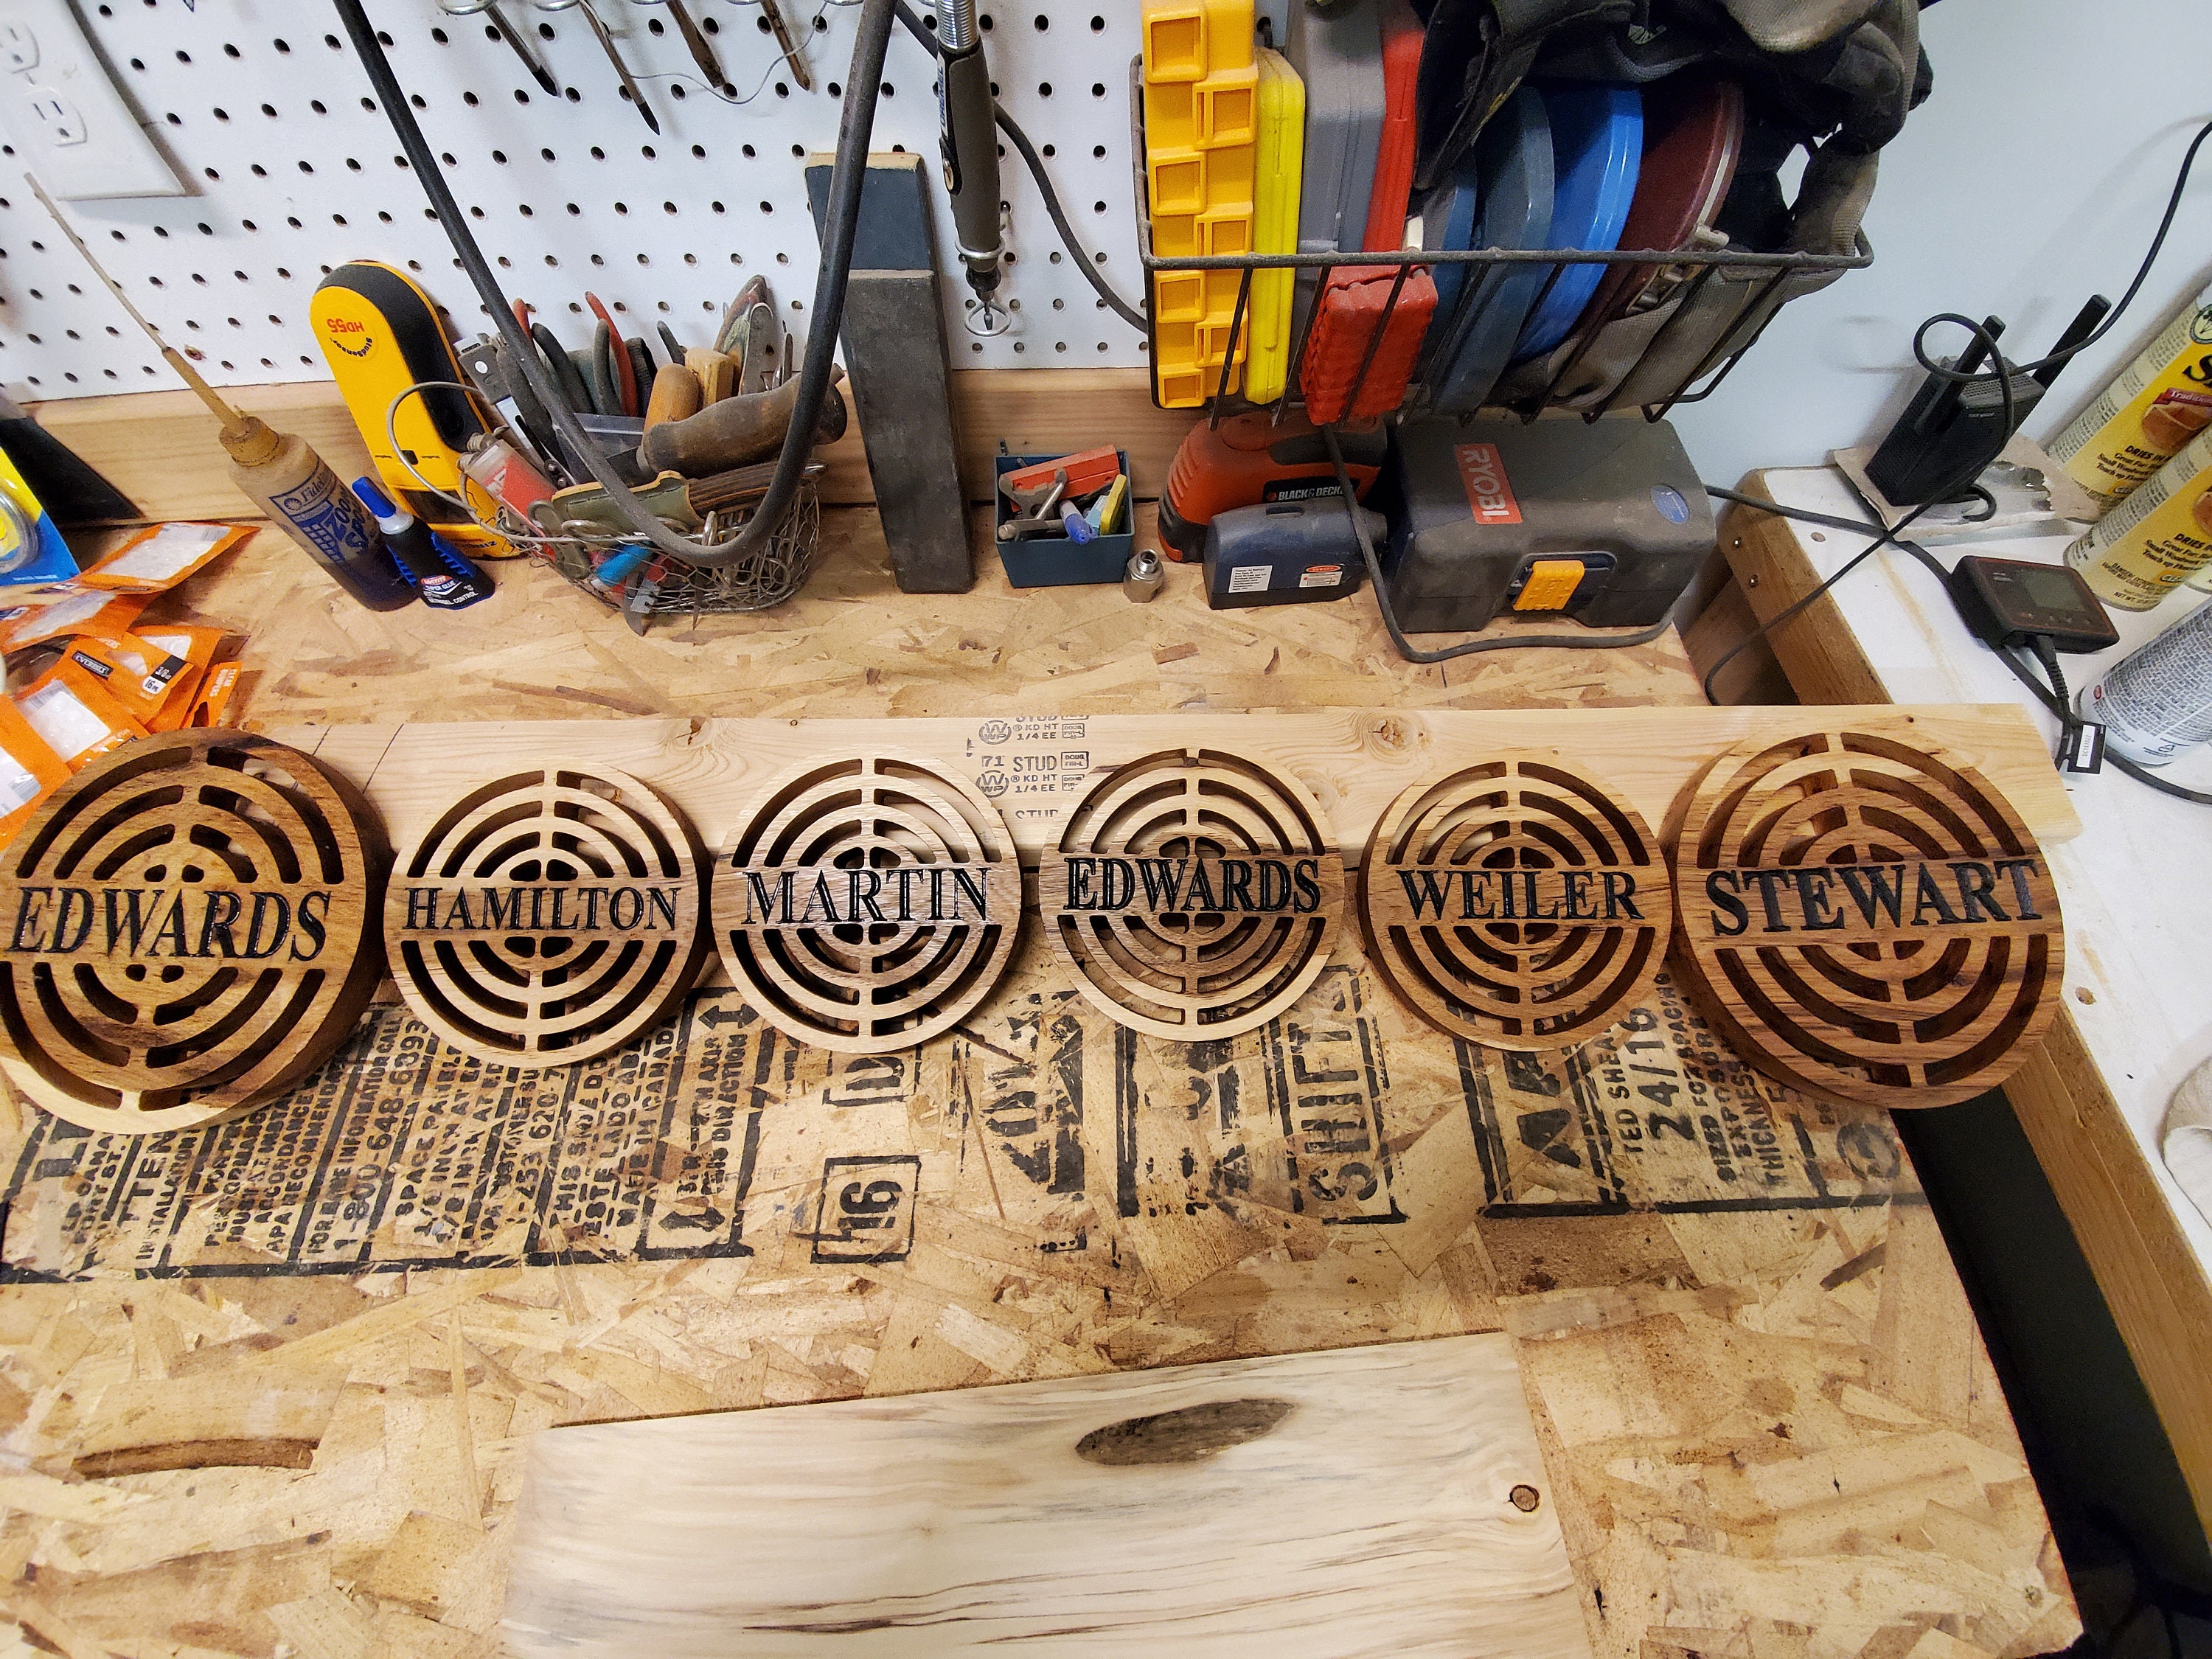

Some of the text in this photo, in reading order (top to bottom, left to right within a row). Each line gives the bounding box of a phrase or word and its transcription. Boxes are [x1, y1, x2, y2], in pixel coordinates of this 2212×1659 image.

[937, 66, 946, 128] DREMEL
[327, 319, 364, 333] HD55
[1463, 448, 1509, 516] RYOBI
[2125, 445, 2153, 459] DRIES
[2174, 532, 2205, 549] DRIES
[145, 678, 154, 690] 16
[1013, 755, 1057, 772] STUD
[403, 886, 681, 931] HAMILTON
[742, 867, 992, 925] MARTIN
[1064, 858, 1320, 915] EDWARDS
[1396, 869, 1645, 921] WEILER
[1705, 859, 2043, 937] STEWART
[7, 886, 330, 961] EDWARDS
[518, 1068, 539, 1092] SU
[712, 1033, 748, 1143] DIRECTION
[1618, 1006, 1696, 1140] 24/16
[1653, 973, 1736, 1183] SIZED FOR SPACING
[308, 1220, 332, 1253] FOR
[336, 1056, 389, 1163] INFORMATION
[375, 1017, 403, 1054] CALL
[333, 1020, 431, 1251] 1-800-648-6393
[472, 1098, 495, 1122] AT
[600, 1093, 630, 1160] LADO
[1287, 1022, 1378, 1201] SHIFT
[76, 1133, 114, 1196] CANA
[116, 1131, 177, 1226] TTEN
[204, 1105, 271, 1246] PERFORMANC
[256, 1094, 313, 1222] ACCORDANCE
[395, 1135, 429, 1217] SPACE
[616, 1153, 650, 1227] MADE
[634, 1119, 657, 1145] IN
[266, 1212, 292, 1253] APA
[586, 1167, 615, 1237] ESTE
